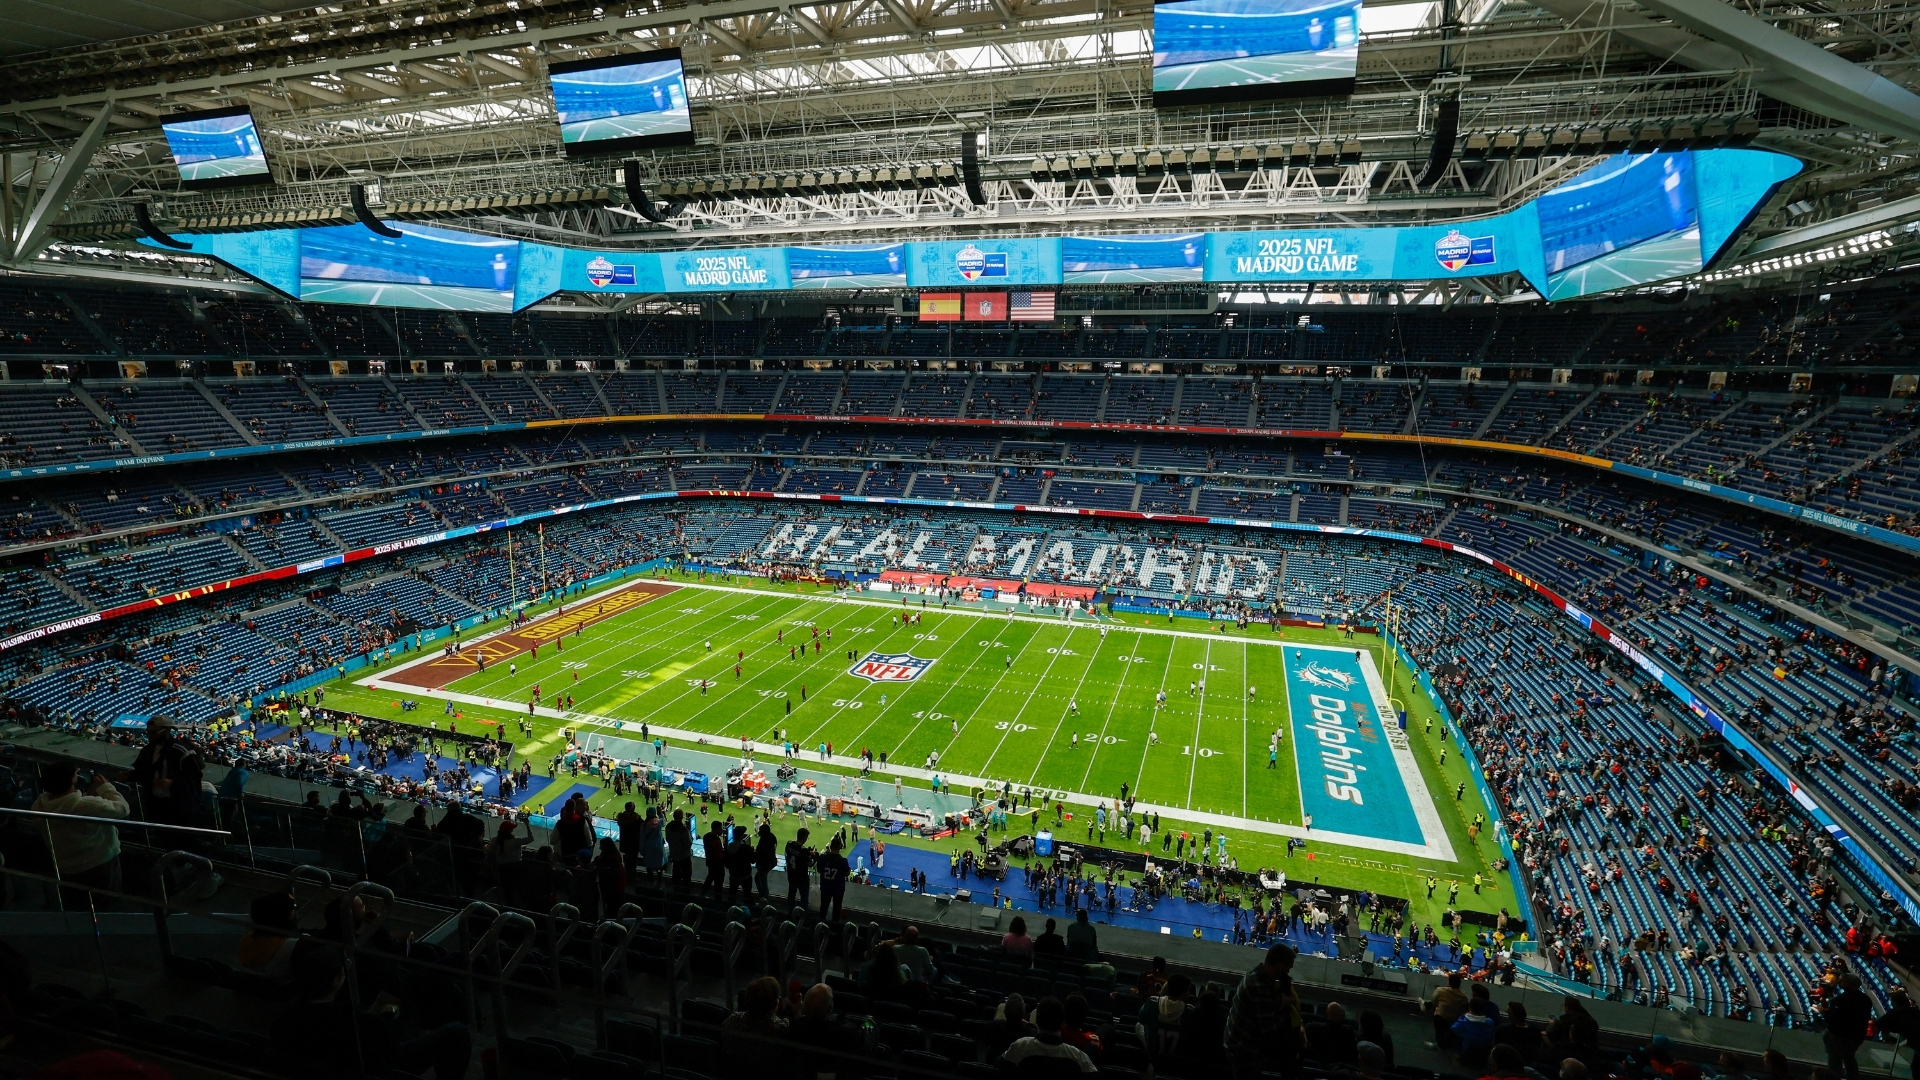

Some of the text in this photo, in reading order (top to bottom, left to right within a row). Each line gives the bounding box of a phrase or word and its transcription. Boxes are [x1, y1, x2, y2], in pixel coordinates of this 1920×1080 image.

[1258, 238, 1336, 256] 2025 NFL
[1438, 248, 1468, 256] MADRID
[696, 256, 750, 271] 2025 NFL
[1237, 254, 1358, 274] MADRID GAME
[686, 270, 768, 285] MADRID GAME
[136, 456, 164, 464] DOLPHINS
[1802, 509, 1858, 532] 2025 NFL MADRID GAME
[374, 532, 446, 554] 2025 NFL MADRID GAME
[762, 523, 1270, 598] REAL MADRID
[519, 591, 650, 640] COMMANDERS
[0, 614, 101, 650] WASHINGTON COMMANDERS
[1046, 647, 1074, 656] 30
[1608, 632, 1664, 682] 2025 NFL MADRID GAME
[622, 670, 650, 679] 20
[856, 662, 913, 680] NFL
[1192, 663, 1219, 671] 10
[760, 690, 788, 698] 40
[832, 699, 863, 710] 50
[911, 711, 943, 721] 40
[995, 721, 1028, 732] 30
[1378, 706, 1407, 750] END RACISM
[1083, 733, 1118, 745] 20
[1181, 746, 1213, 758] 10
[1305, 693, 1366, 806] Dolphins
[824, 867, 838, 880] 27
[1158, 1028, 1180, 1054] 17
